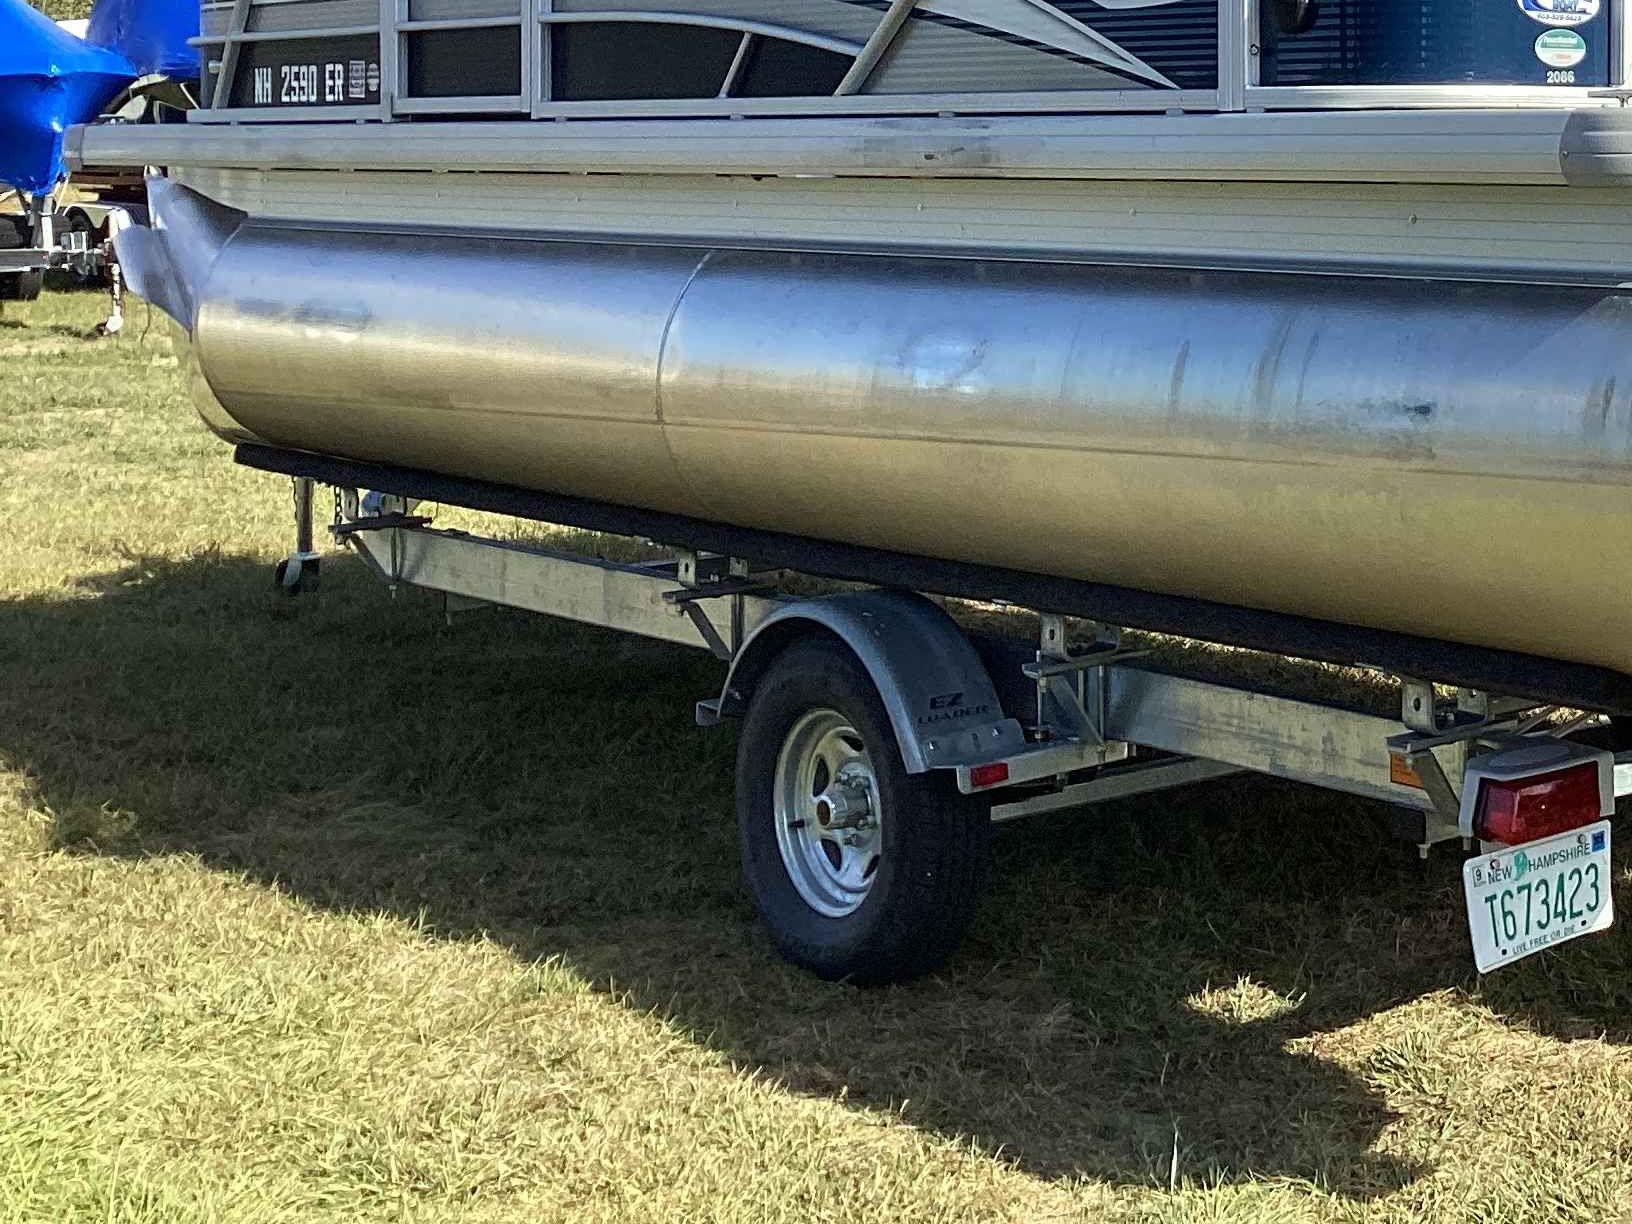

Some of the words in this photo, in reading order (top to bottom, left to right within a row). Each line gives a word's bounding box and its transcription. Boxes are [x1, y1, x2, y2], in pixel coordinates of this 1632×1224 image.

[254, 67, 272, 104] NH
[281, 65, 317, 102] 2590
[325, 63, 344, 102] ER
[1546, 70, 1575, 84] 2086
[929, 692, 964, 710] EZ
[918, 704, 989, 724] LOADER
[1487, 865, 1513, 885] NEW
[1528, 843, 1591, 873] HAMPSHIRE
[1484, 863, 1600, 948] T673423
[1512, 941, 1528, 954] LIVE
[1529, 934, 1550, 948] FREE
